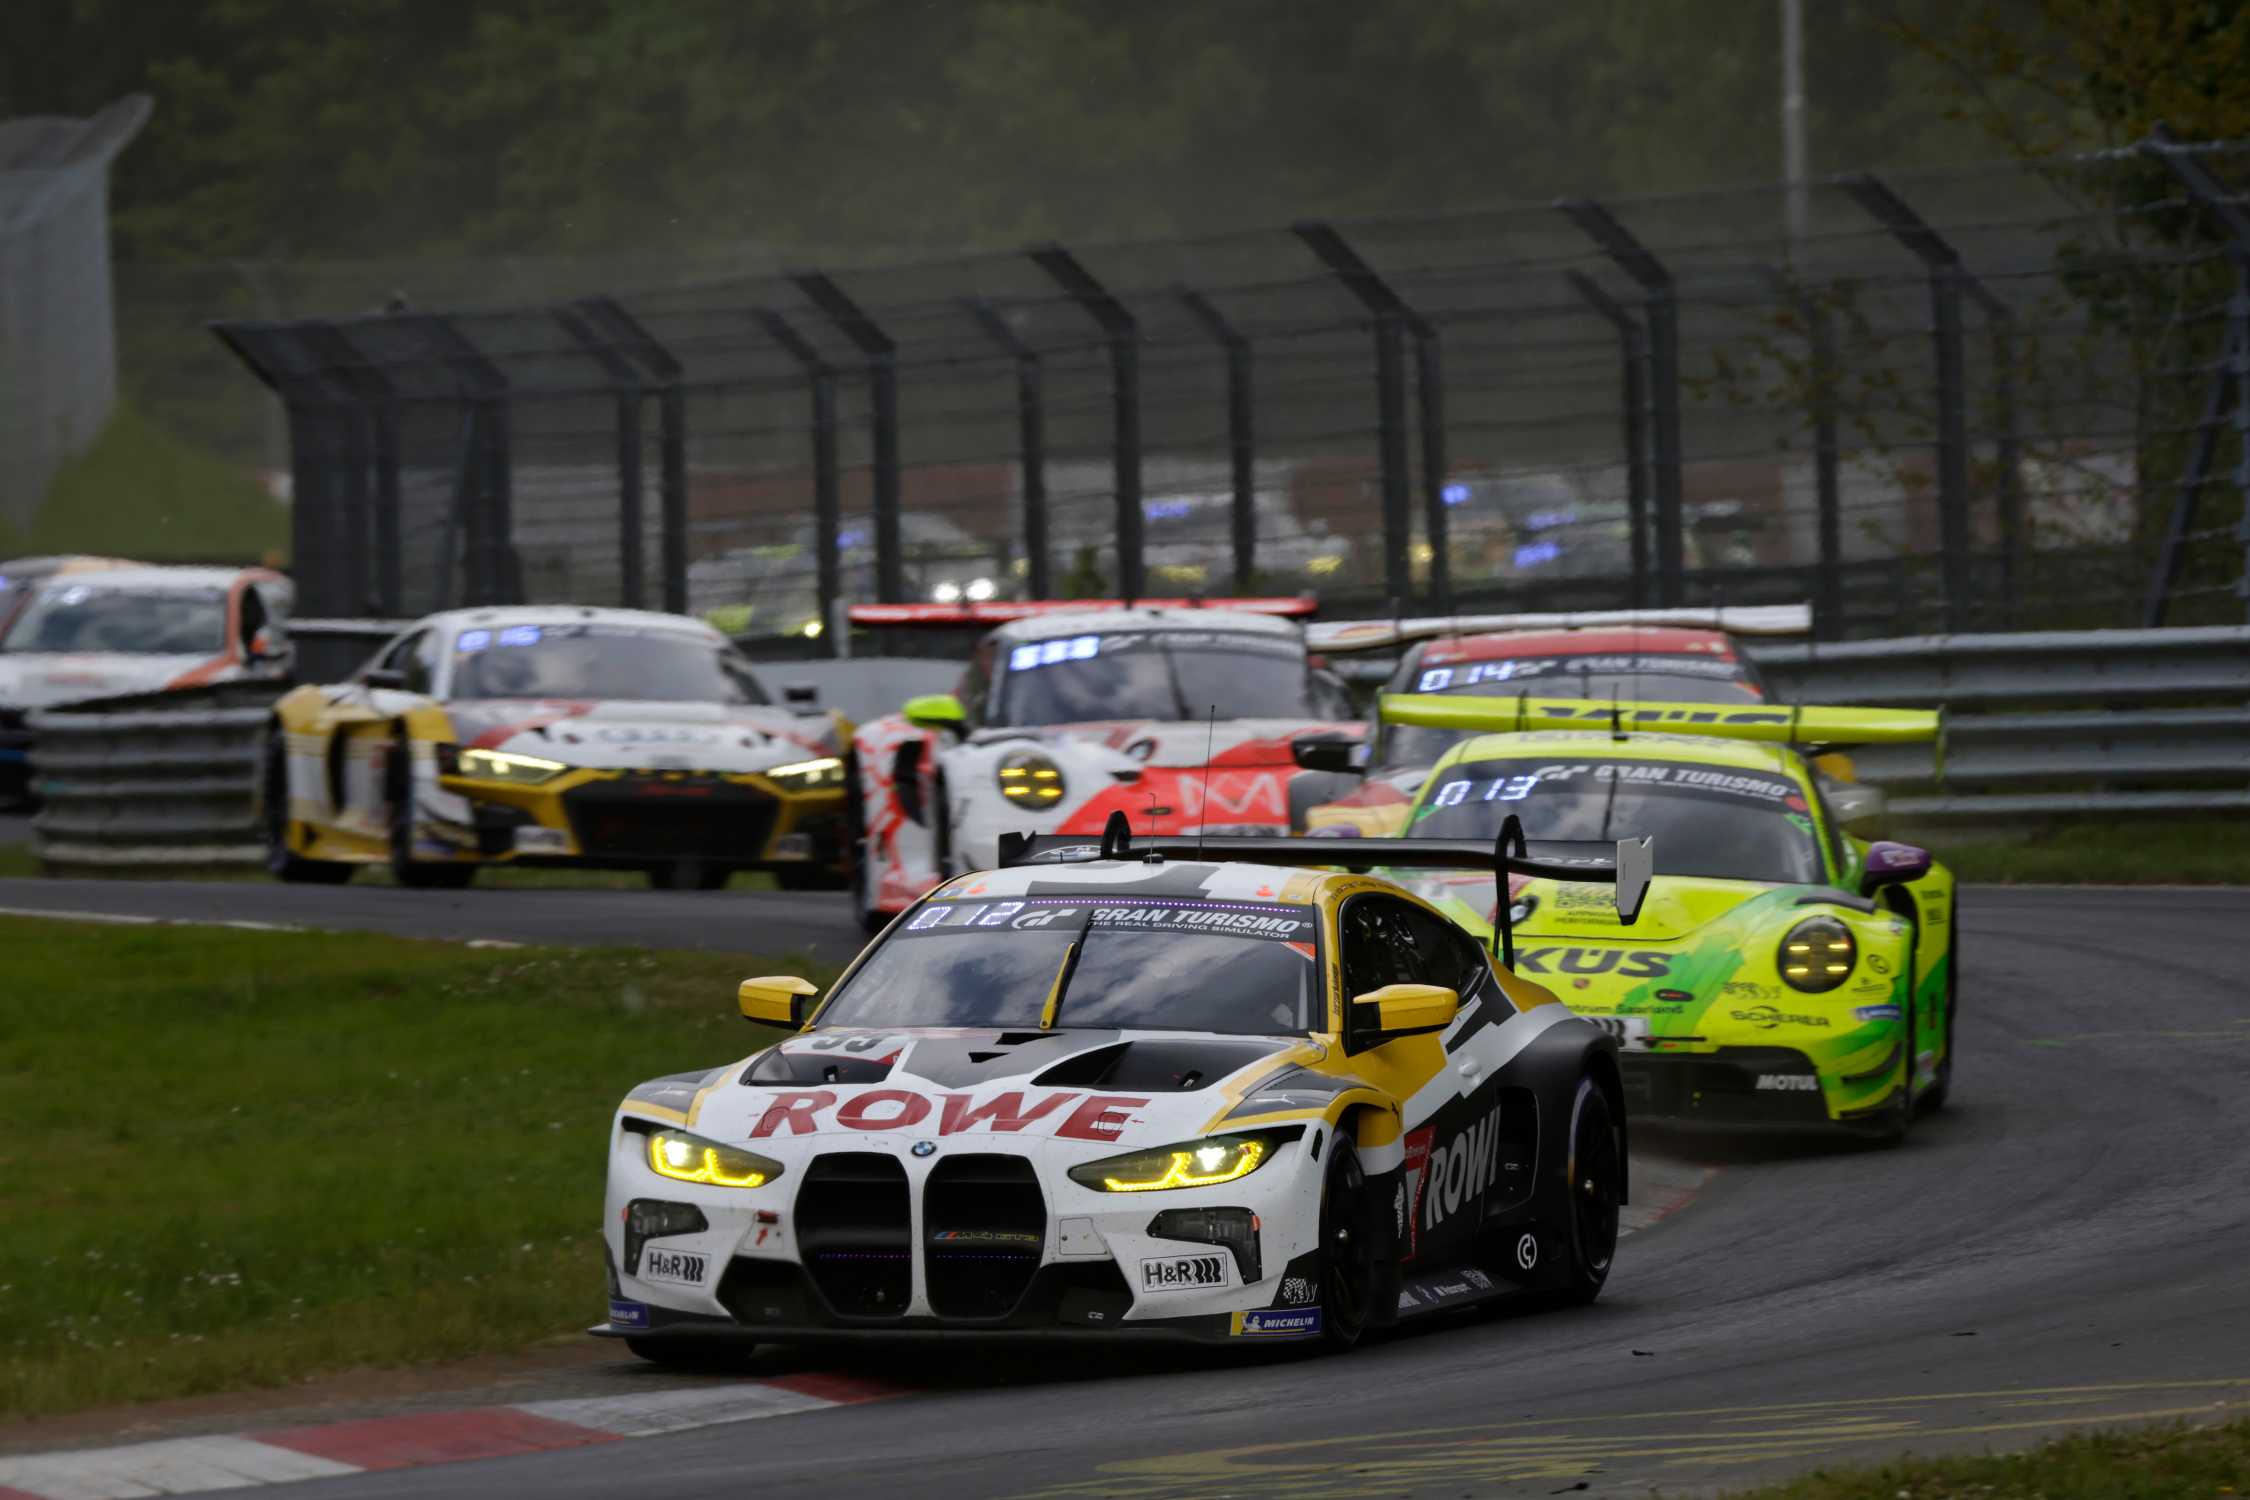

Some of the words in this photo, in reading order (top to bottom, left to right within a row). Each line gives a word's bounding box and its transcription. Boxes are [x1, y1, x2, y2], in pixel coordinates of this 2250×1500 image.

[1594, 765, 1667, 781] GRAN
[1674, 769, 1787, 796] TURISMO
[1091, 908, 1169, 922] GRAN
[1173, 910, 1300, 932] TURISMO
[1153, 922, 1208, 930] DRIVING
[1212, 926, 1290, 938] SIMULATOR
[1513, 947, 1673, 977] KÜS
[1755, 1074, 1819, 1090] MOTUL
[749, 1090, 1151, 1142] ROWE
[1426, 1104, 1501, 1231] ROW
[649, 1252, 681, 1277] H&R
[1144, 1261, 1192, 1285] H&R
[1264, 1316, 1314, 1328] MICHELIN
